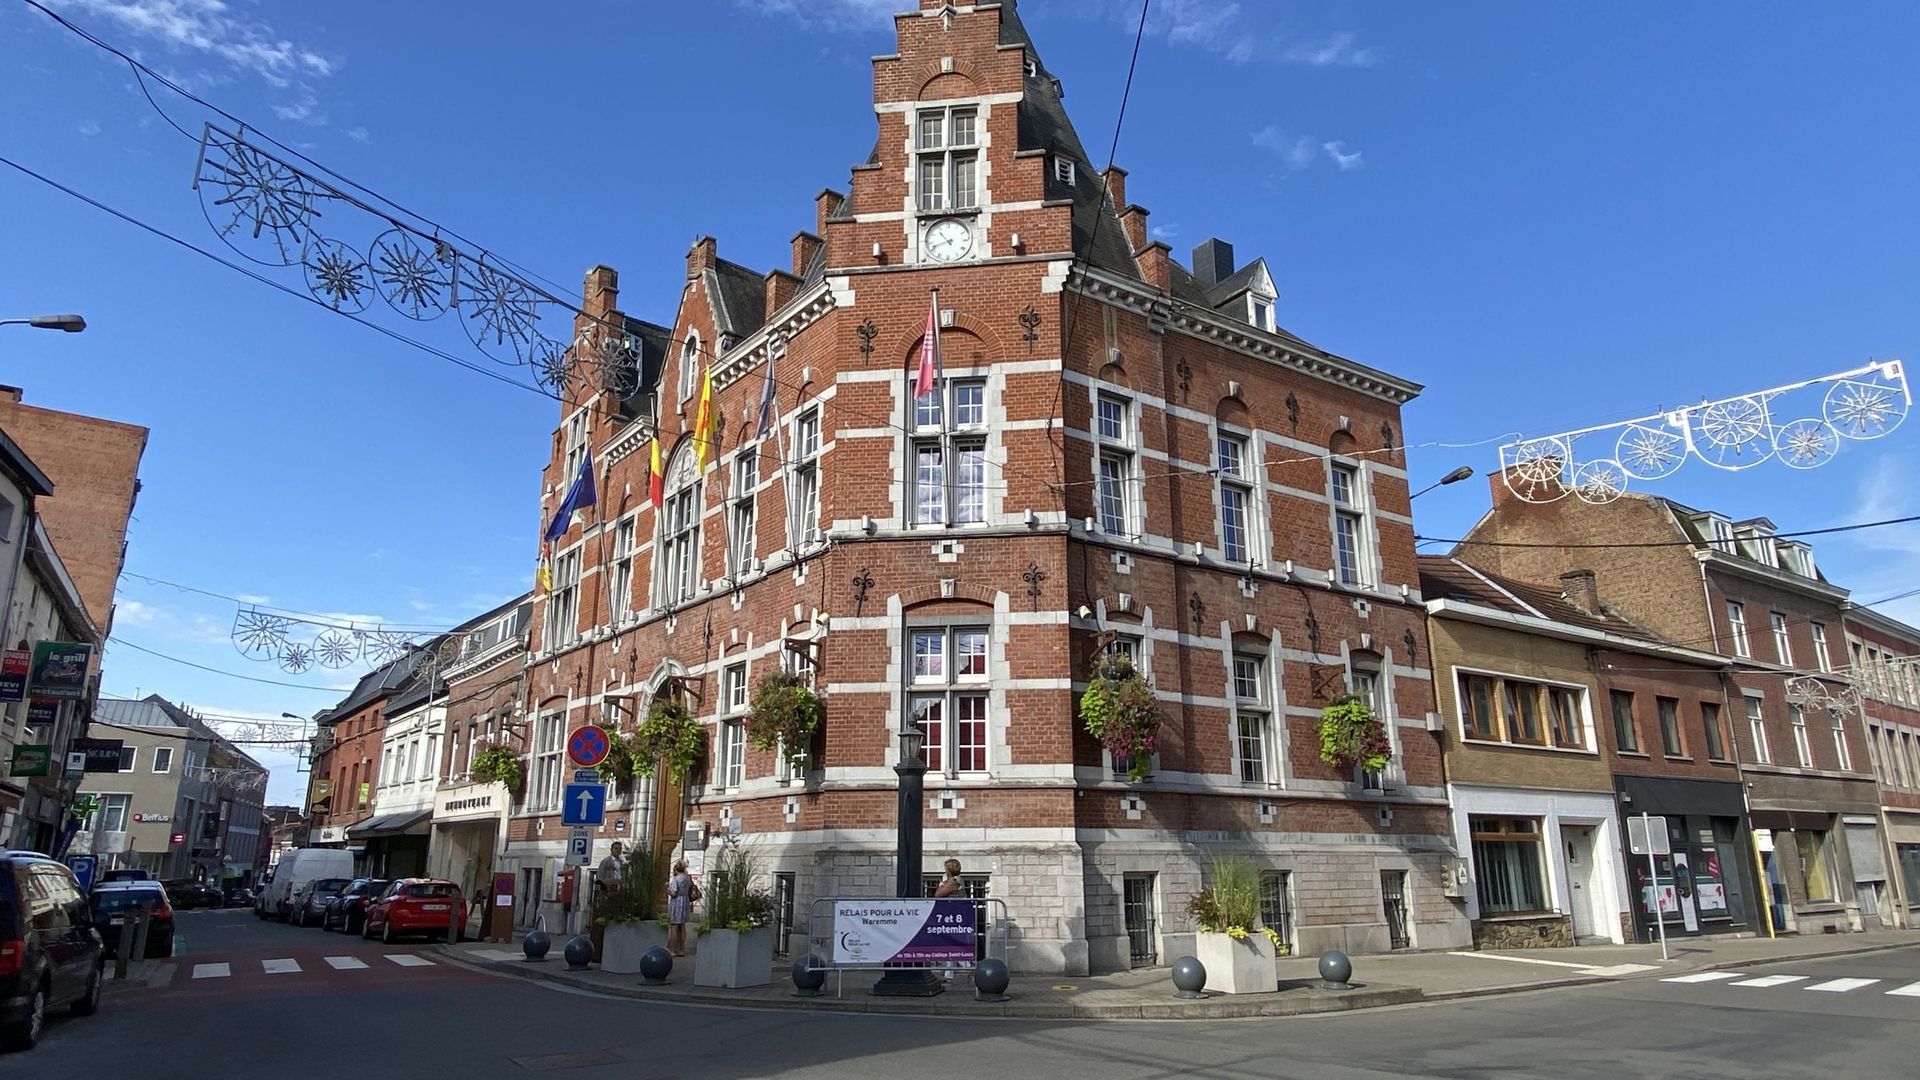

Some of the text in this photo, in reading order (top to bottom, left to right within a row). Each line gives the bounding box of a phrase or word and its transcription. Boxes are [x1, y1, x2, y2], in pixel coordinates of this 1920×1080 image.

[49, 651, 86, 662] le grill
[142, 813, 169, 822] Belfius
[575, 839, 585, 855] P
[74, 861, 89, 875] P
[906, 908, 920, 916] VIE
[936, 914, 963, 923] 7 et 8
[927, 925, 973, 935] septembre
